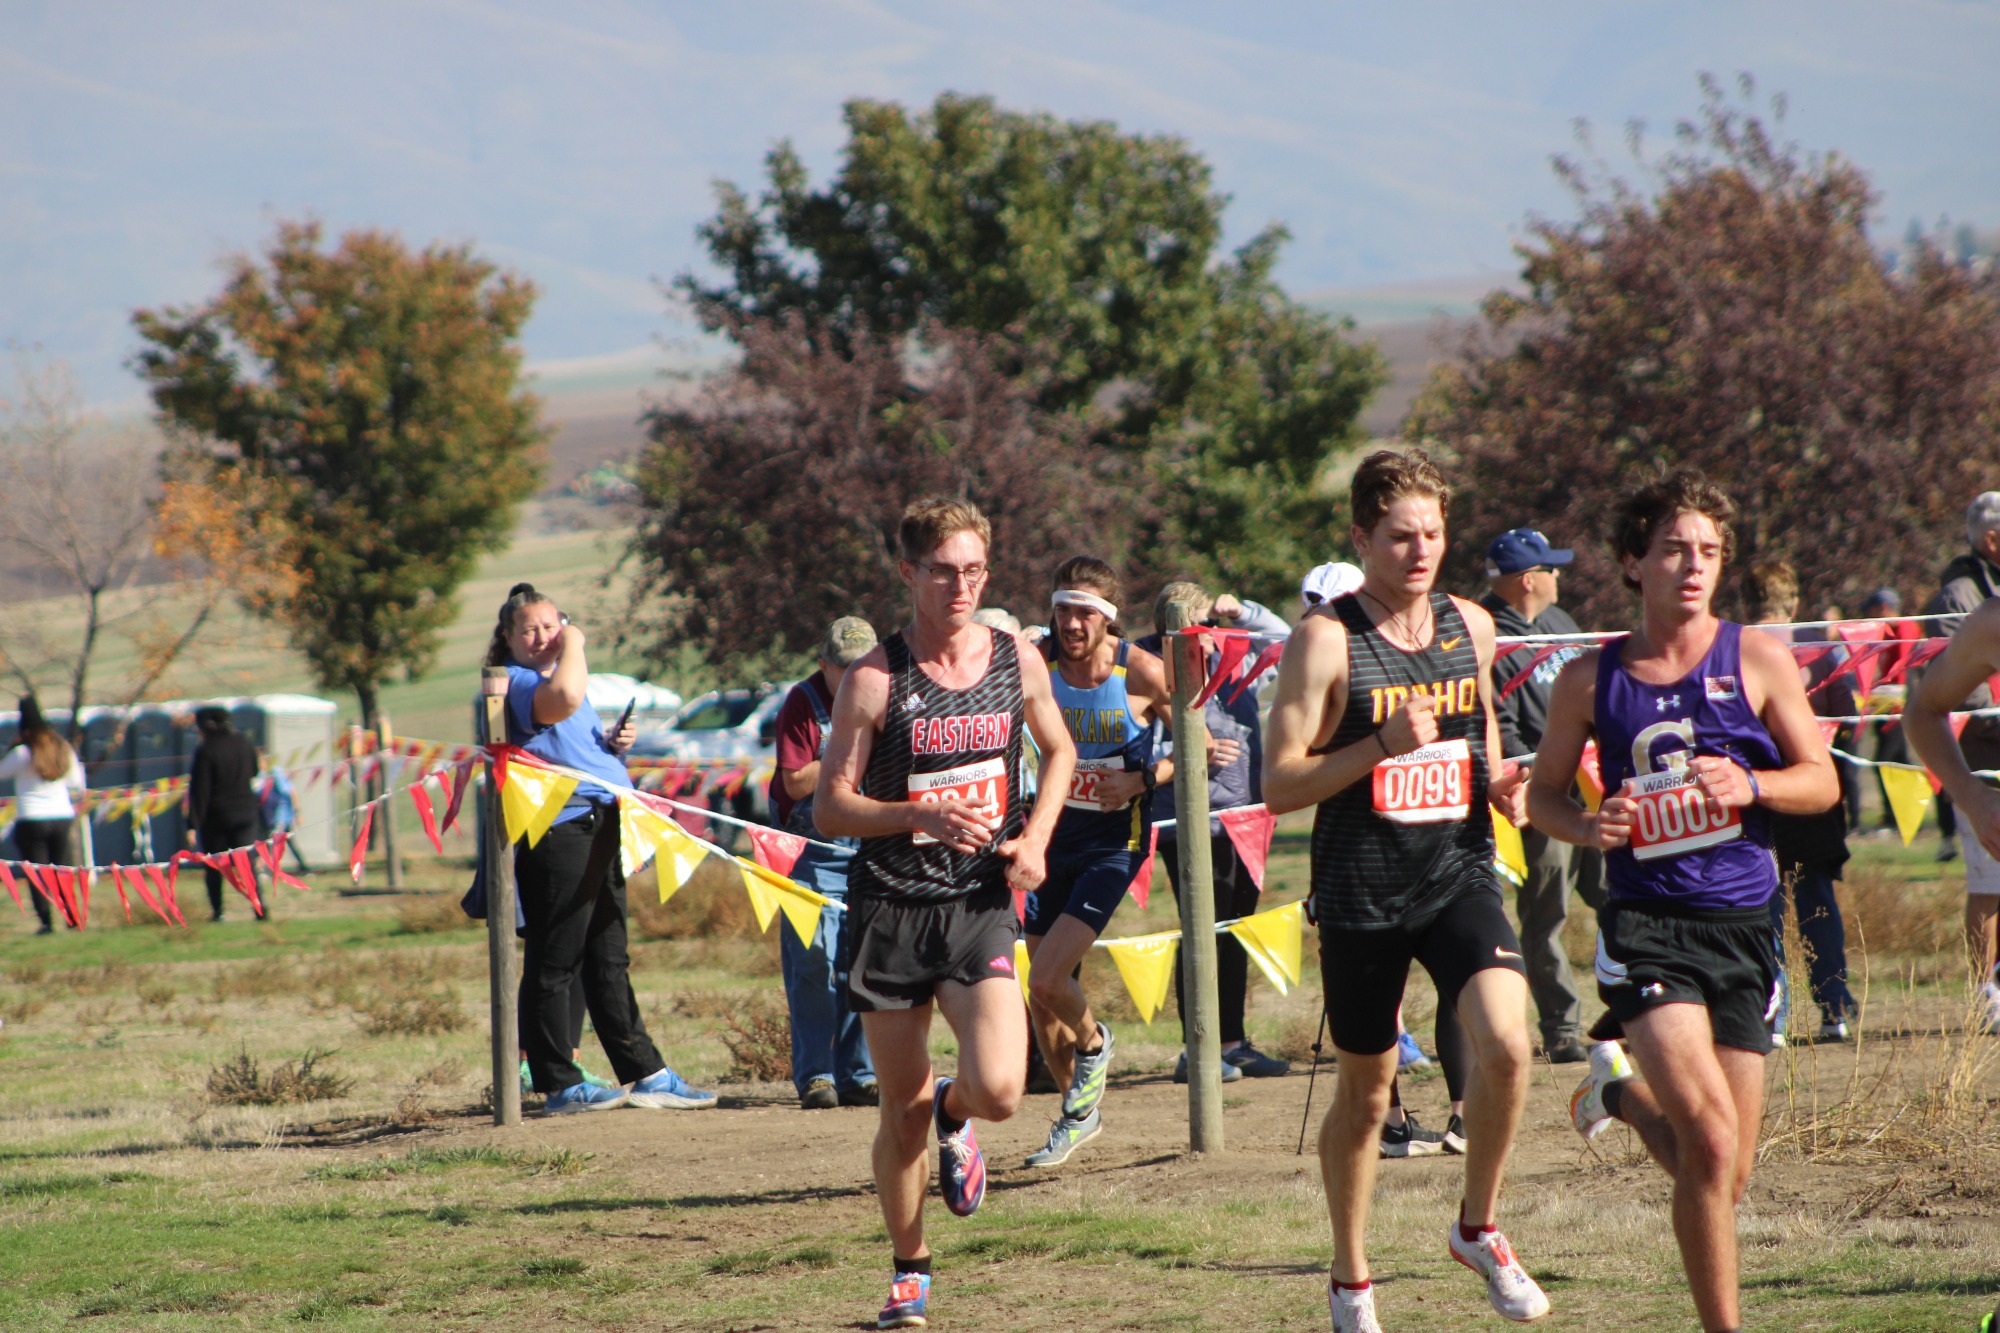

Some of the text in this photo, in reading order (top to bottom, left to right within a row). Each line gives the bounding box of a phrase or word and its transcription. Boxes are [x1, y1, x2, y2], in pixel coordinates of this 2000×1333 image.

[912, 712, 1011, 754] EASTERN
[1062, 708, 1125, 743] OKANE
[1396, 748, 1452, 763] WARRIORS
[929, 768, 988, 788] WARRIORS
[1067, 772, 1101, 800] 22
[1385, 761, 1461, 808] 0099
[920, 778, 1000, 817] 44
